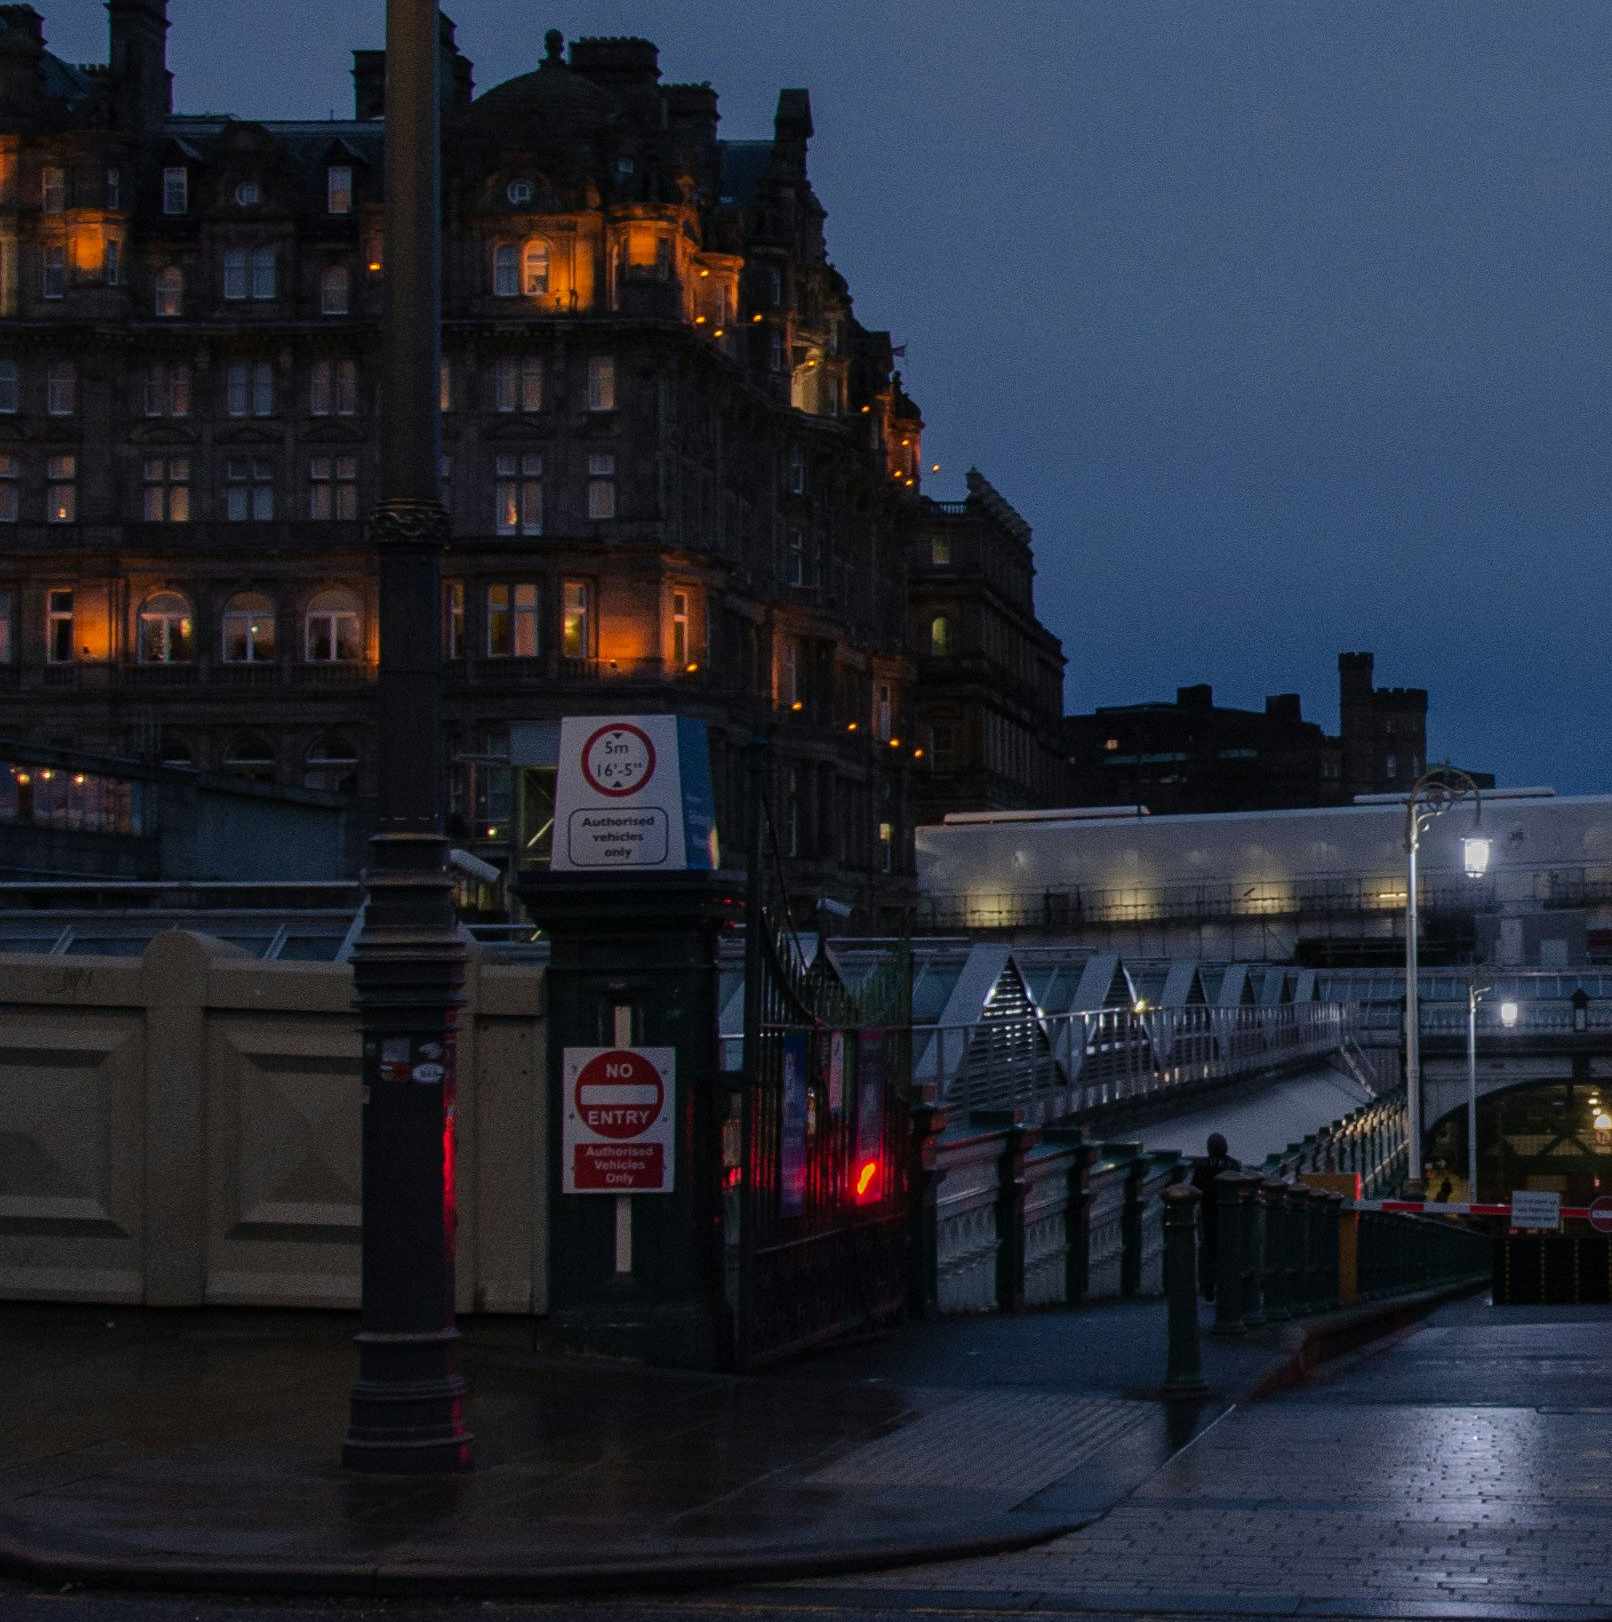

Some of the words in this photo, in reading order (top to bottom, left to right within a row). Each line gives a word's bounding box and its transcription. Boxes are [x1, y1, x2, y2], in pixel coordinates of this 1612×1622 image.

[604, 741, 629, 755] 5m
[582, 816, 655, 828] Authorised
[592, 832, 644, 842] vehicles
[604, 847, 632, 859] only
[606, 1063, 634, 1079] NO
[587, 1109, 650, 1126] ENTRY
[585, 1146, 655, 1157] Authorised
[594, 1159, 646, 1170] Vehicles
[605, 1173, 635, 1186] Only
